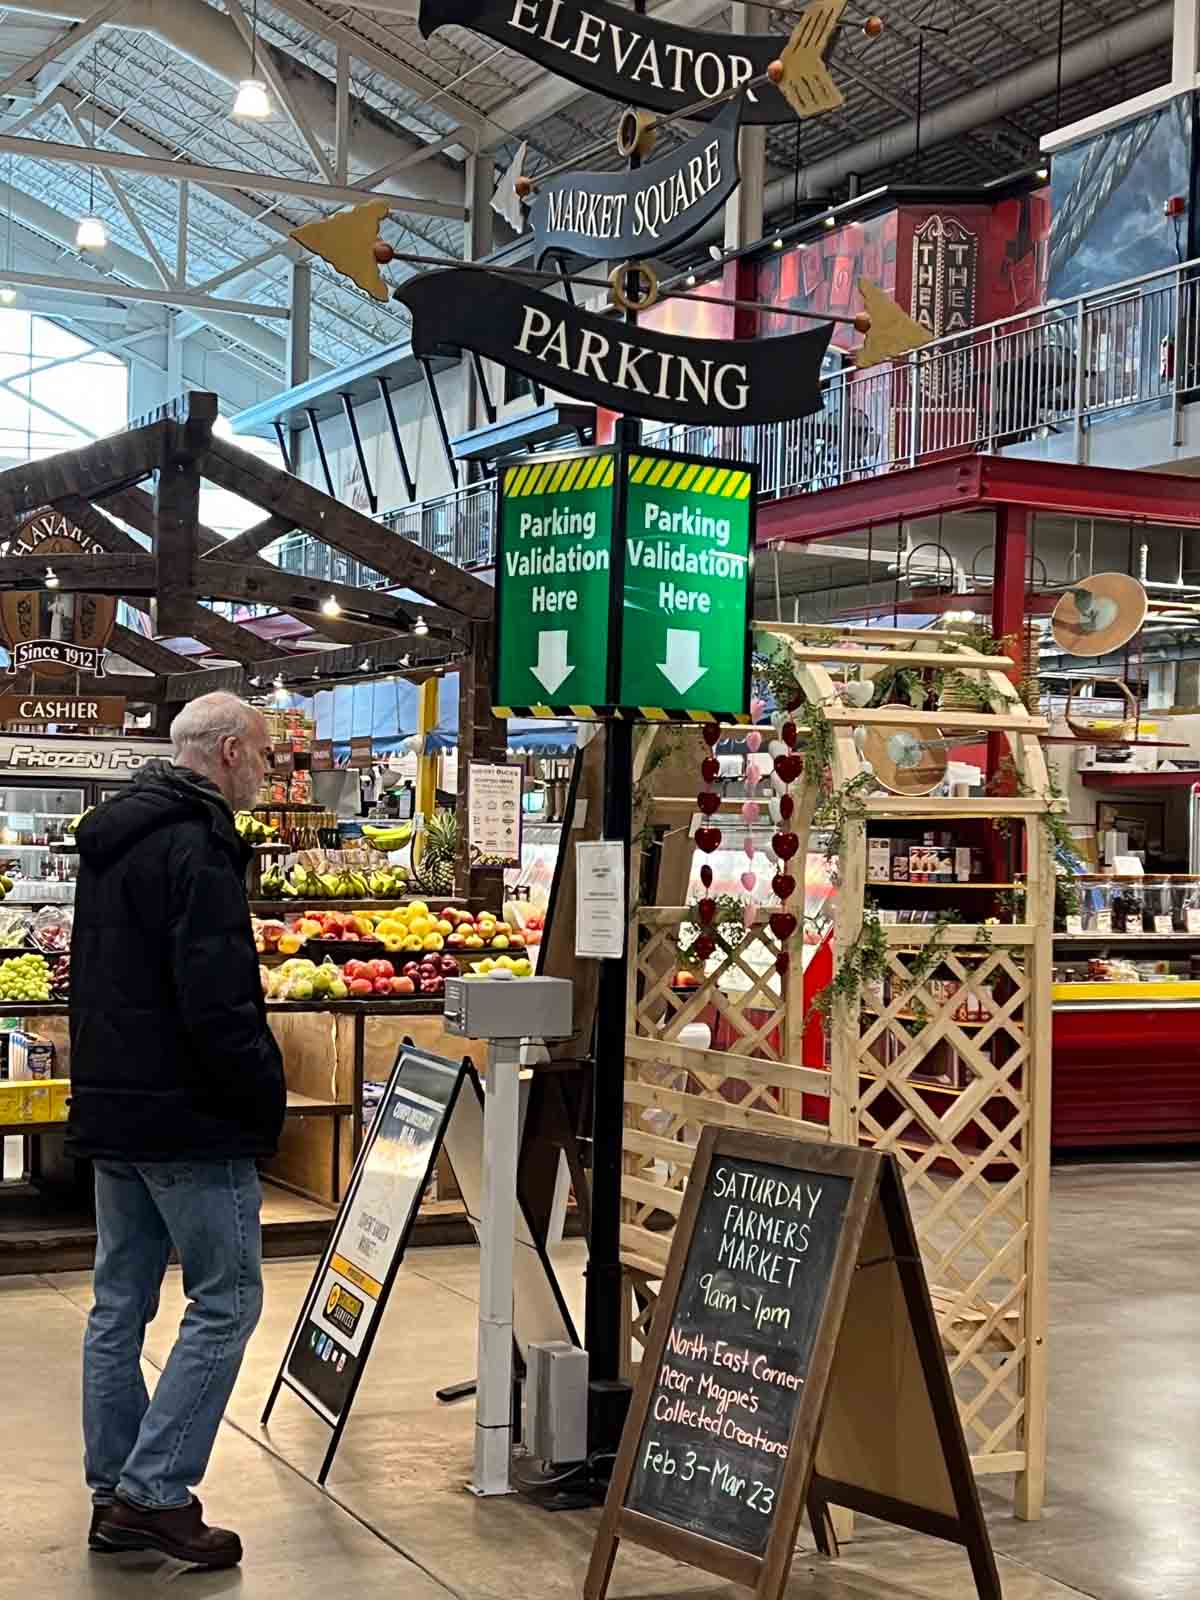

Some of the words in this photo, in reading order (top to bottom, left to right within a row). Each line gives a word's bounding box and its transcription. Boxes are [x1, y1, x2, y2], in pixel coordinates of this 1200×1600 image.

[507, 0, 758, 102] ELEVATOR
[547, 190, 627, 239] MARKET
[632, 139, 721, 237] SQUARE
[513, 305, 751, 411] PARKING
[520, 508, 596, 540] Parking
[644, 502, 730, 547] Parking
[505, 543, 610, 577] Validation
[626, 538, 745, 579] Validation
[532, 585, 578, 612] Here
[658, 581, 712, 613] Here
[20, 643, 60, 661] Since
[64, 648, 93, 667] 1912
[20, 701, 98, 719] CASHIER
[9, 745, 104, 769] FROZEN
[713, 1167, 823, 1218] SATURDAY
[723, 1204, 810, 1253] FARMERS
[718, 1232, 801, 1289] MARKET
[665, 1327, 708, 1361] North
[713, 1340, 750, 1373] East
[752, 1354, 805, 1391] Corner
[659, 1363, 693, 1394] near
[697, 1372, 760, 1415] Magpie's
[654, 1394, 723, 1435] Collected
[723, 1418, 789, 1459] Creations
[746, 1480, 775, 1514] 23
